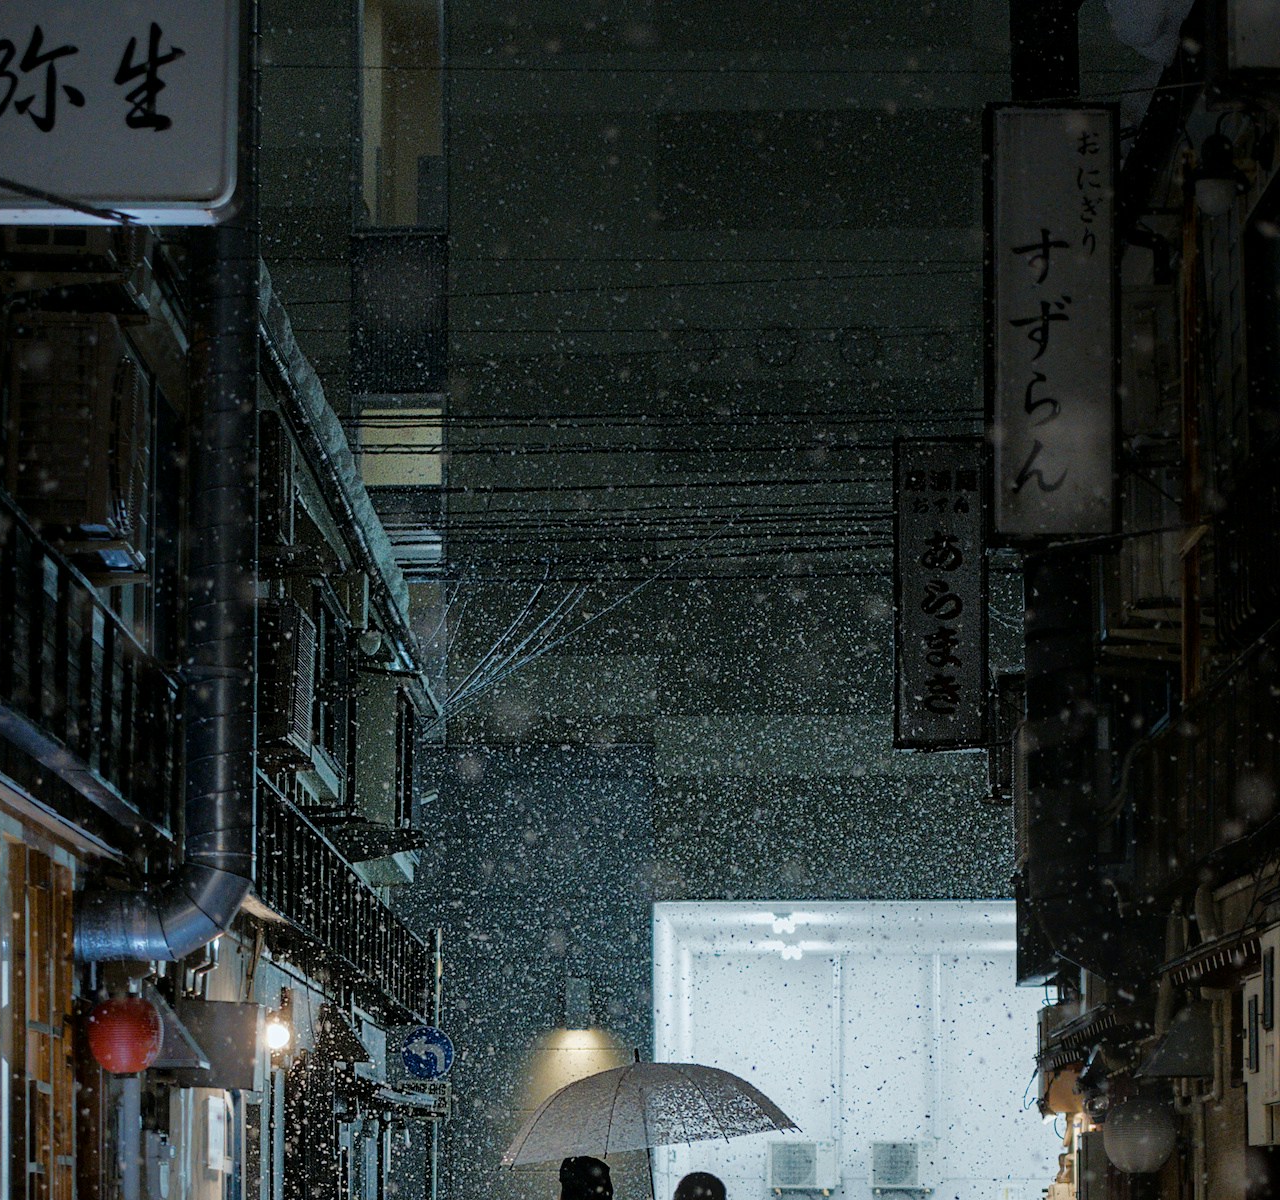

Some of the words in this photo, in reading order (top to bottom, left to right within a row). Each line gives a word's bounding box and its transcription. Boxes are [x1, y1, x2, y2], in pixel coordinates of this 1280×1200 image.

[1075, 130, 1105, 256] おにぎり
[1009, 228, 1072, 494] すずらん
